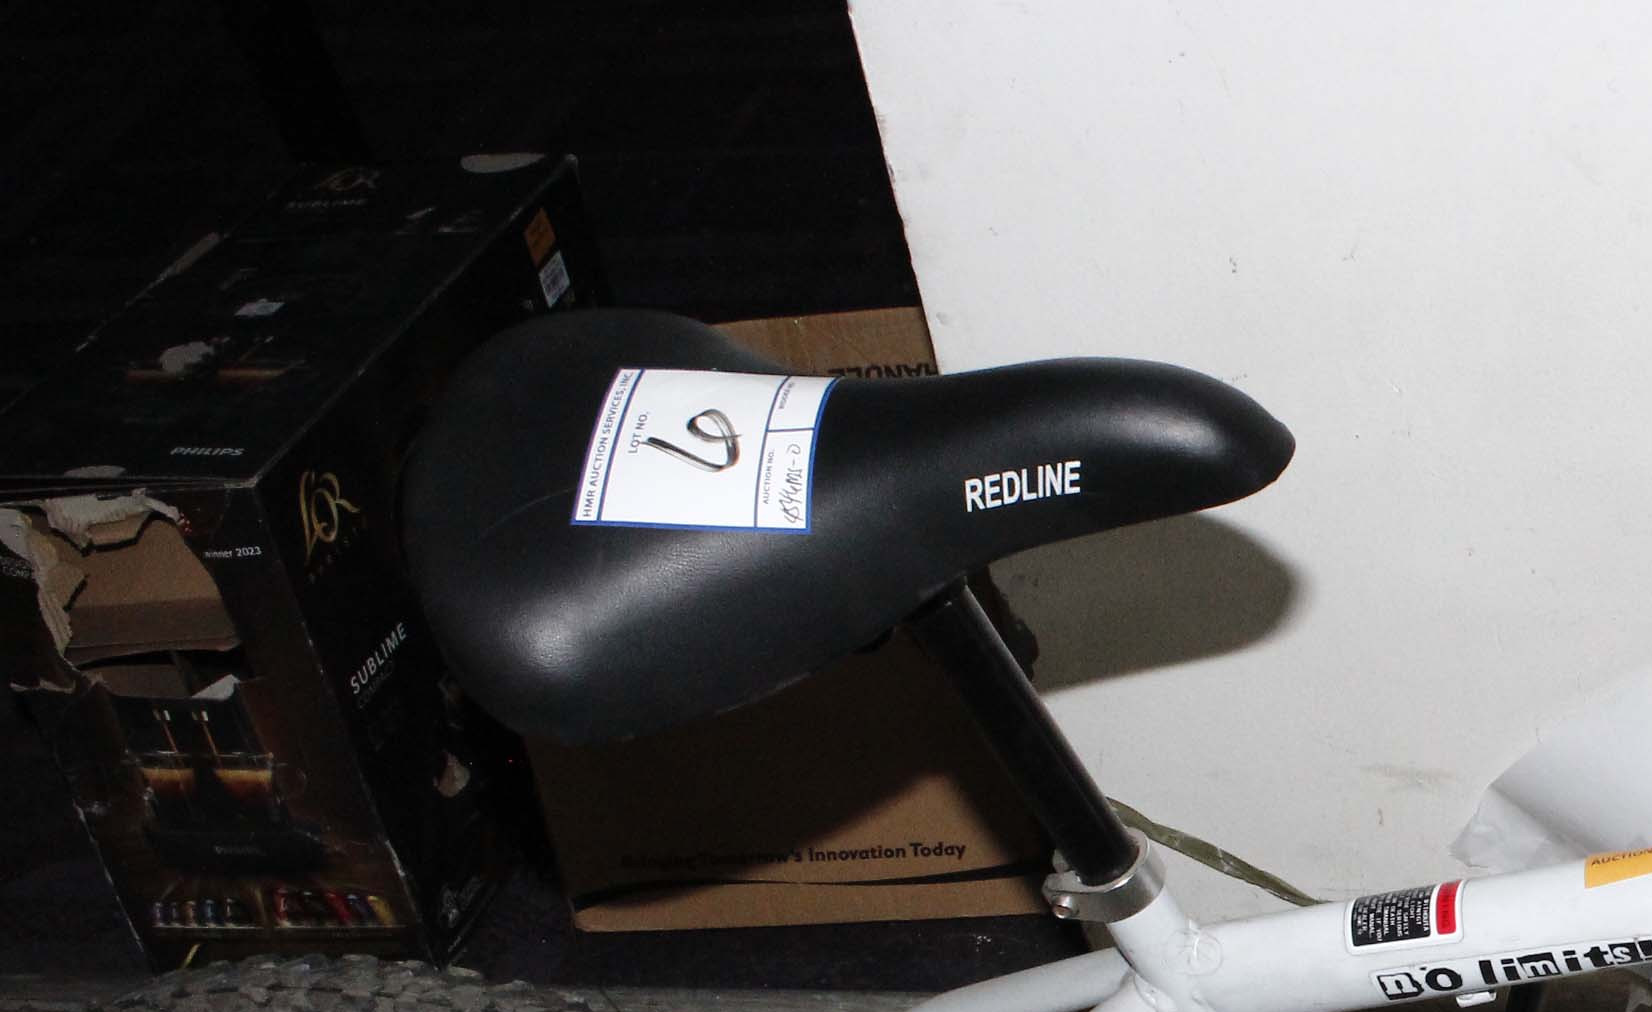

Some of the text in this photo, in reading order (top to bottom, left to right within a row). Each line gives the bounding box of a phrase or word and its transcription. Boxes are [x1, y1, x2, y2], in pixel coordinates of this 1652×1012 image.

[170, 446, 246, 456] PHILIPS
[582, 489, 595, 517] HMR
[589, 437, 608, 487] AUCTION
[602, 387, 626, 435] SERVICES,
[628, 410, 649, 454] LOT NO.
[763, 461, 773, 505] AUCTION
[964, 459, 1082, 513] REDLINE
[235, 546, 262, 558] 2023
[349, 621, 408, 696] SUBLIME
[808, 844, 906, 861] Innovation
[910, 842, 967, 860] Today
[1376, 967, 1463, 1000] no
